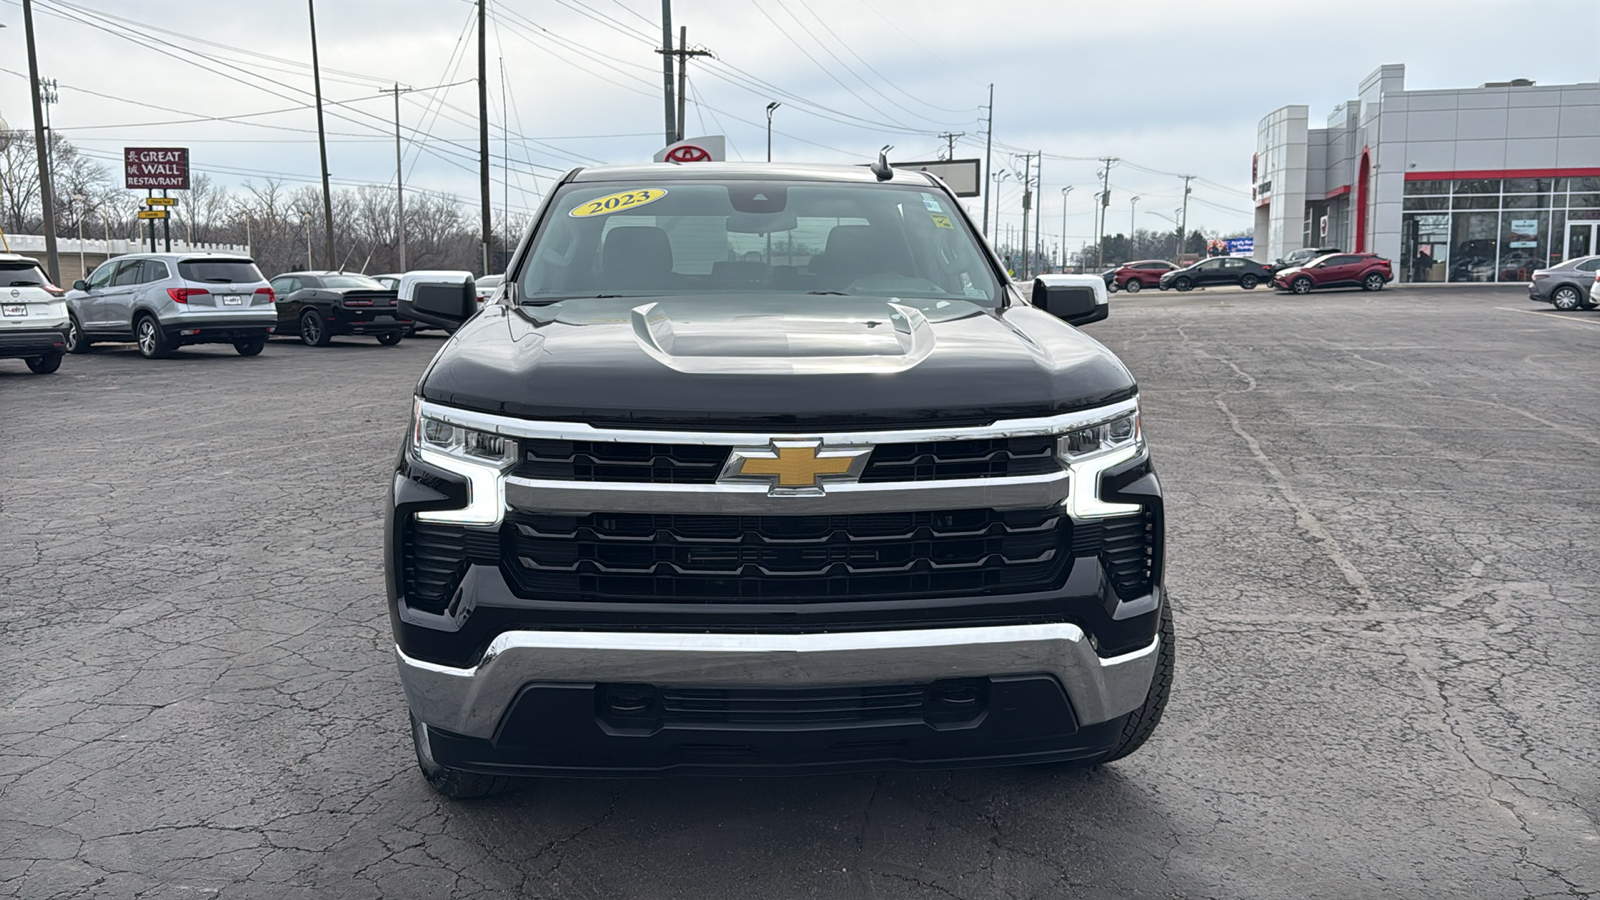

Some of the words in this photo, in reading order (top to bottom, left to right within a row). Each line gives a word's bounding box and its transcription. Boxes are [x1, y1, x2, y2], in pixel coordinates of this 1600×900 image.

[140, 151, 181, 162] GREAT
[141, 163, 180, 175] WALL
[588, 191, 651, 214] 2023
